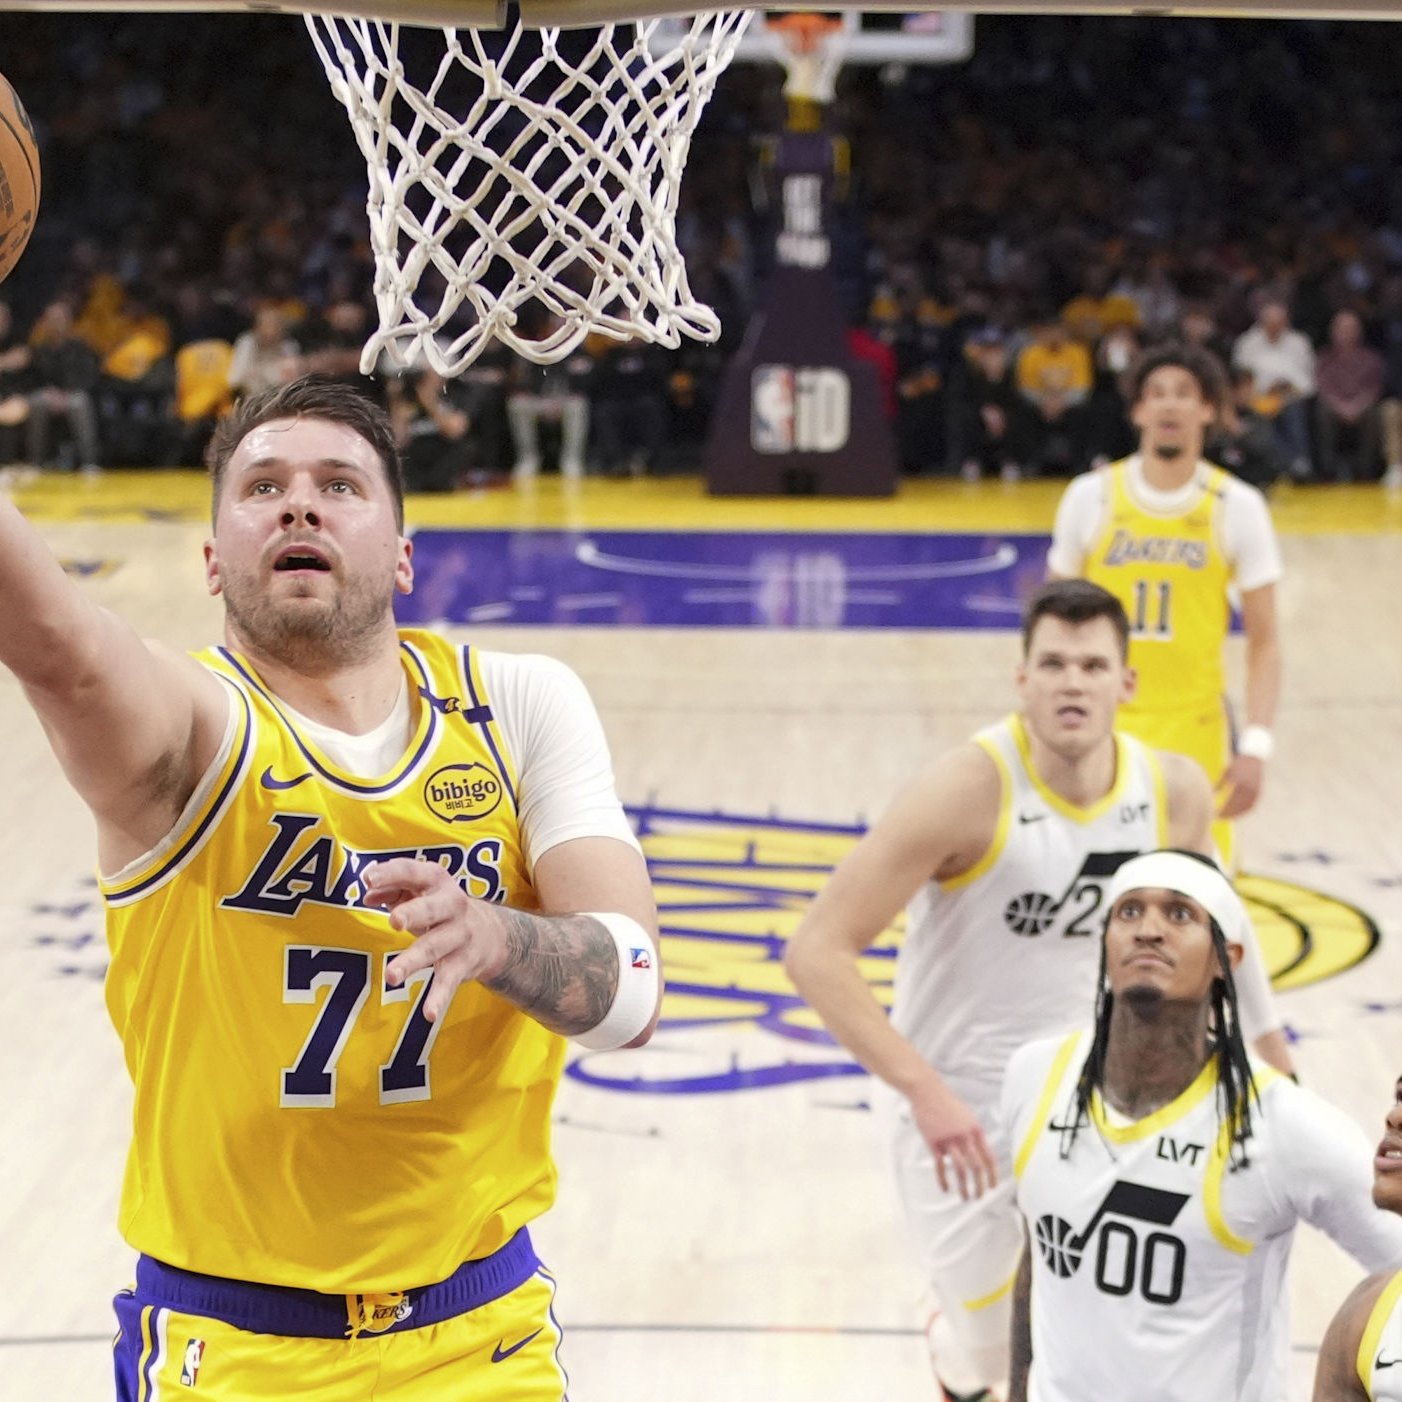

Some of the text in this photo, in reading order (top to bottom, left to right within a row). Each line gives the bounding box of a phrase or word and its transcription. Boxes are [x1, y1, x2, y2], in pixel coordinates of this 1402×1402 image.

[1129, 580, 1173, 641] 11
[430, 778, 497, 803] bibigo
[445, 798, 474, 811] 비비고
[219, 812, 507, 918] LAKRS
[1063, 883, 1104, 938] 2
[280, 944, 451, 1109] 77
[1156, 1136, 1205, 1167] LVT
[1095, 1221, 1187, 1306] 00
